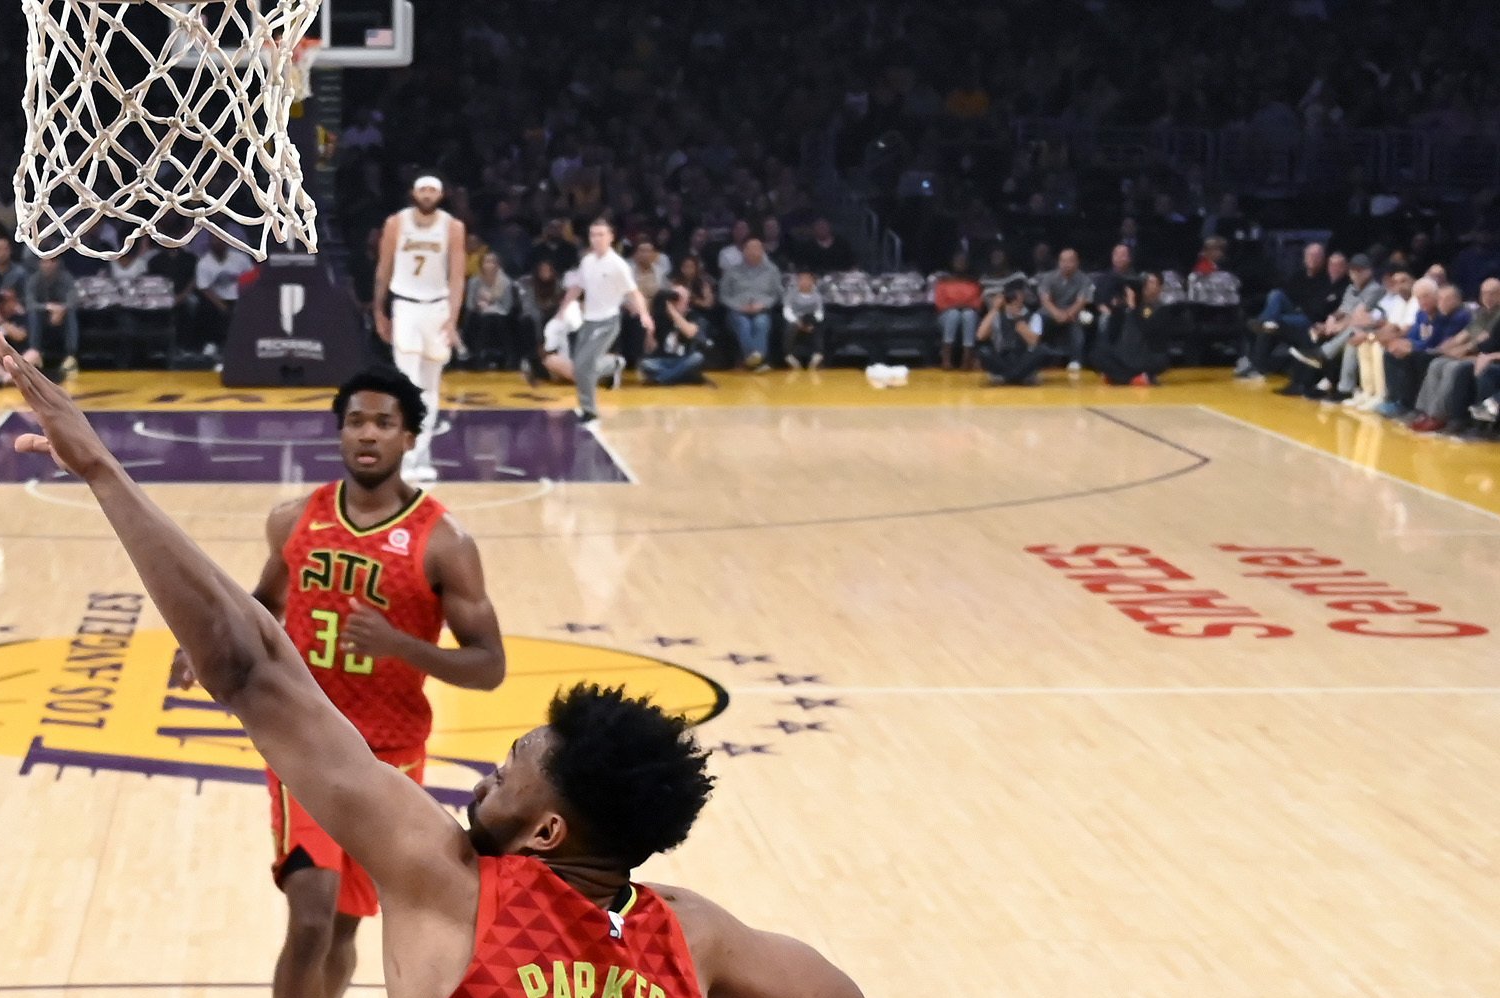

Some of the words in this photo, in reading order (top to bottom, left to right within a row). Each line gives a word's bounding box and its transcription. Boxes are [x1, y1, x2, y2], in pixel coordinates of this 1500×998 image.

[414, 255, 426, 276] 7
[300, 549, 390, 610] ATL
[1023, 543, 1295, 638] STAPLES
[1212, 543, 1490, 638] Center
[63, 592, 145, 682] ANGELES
[40, 685, 117, 729] LOS
